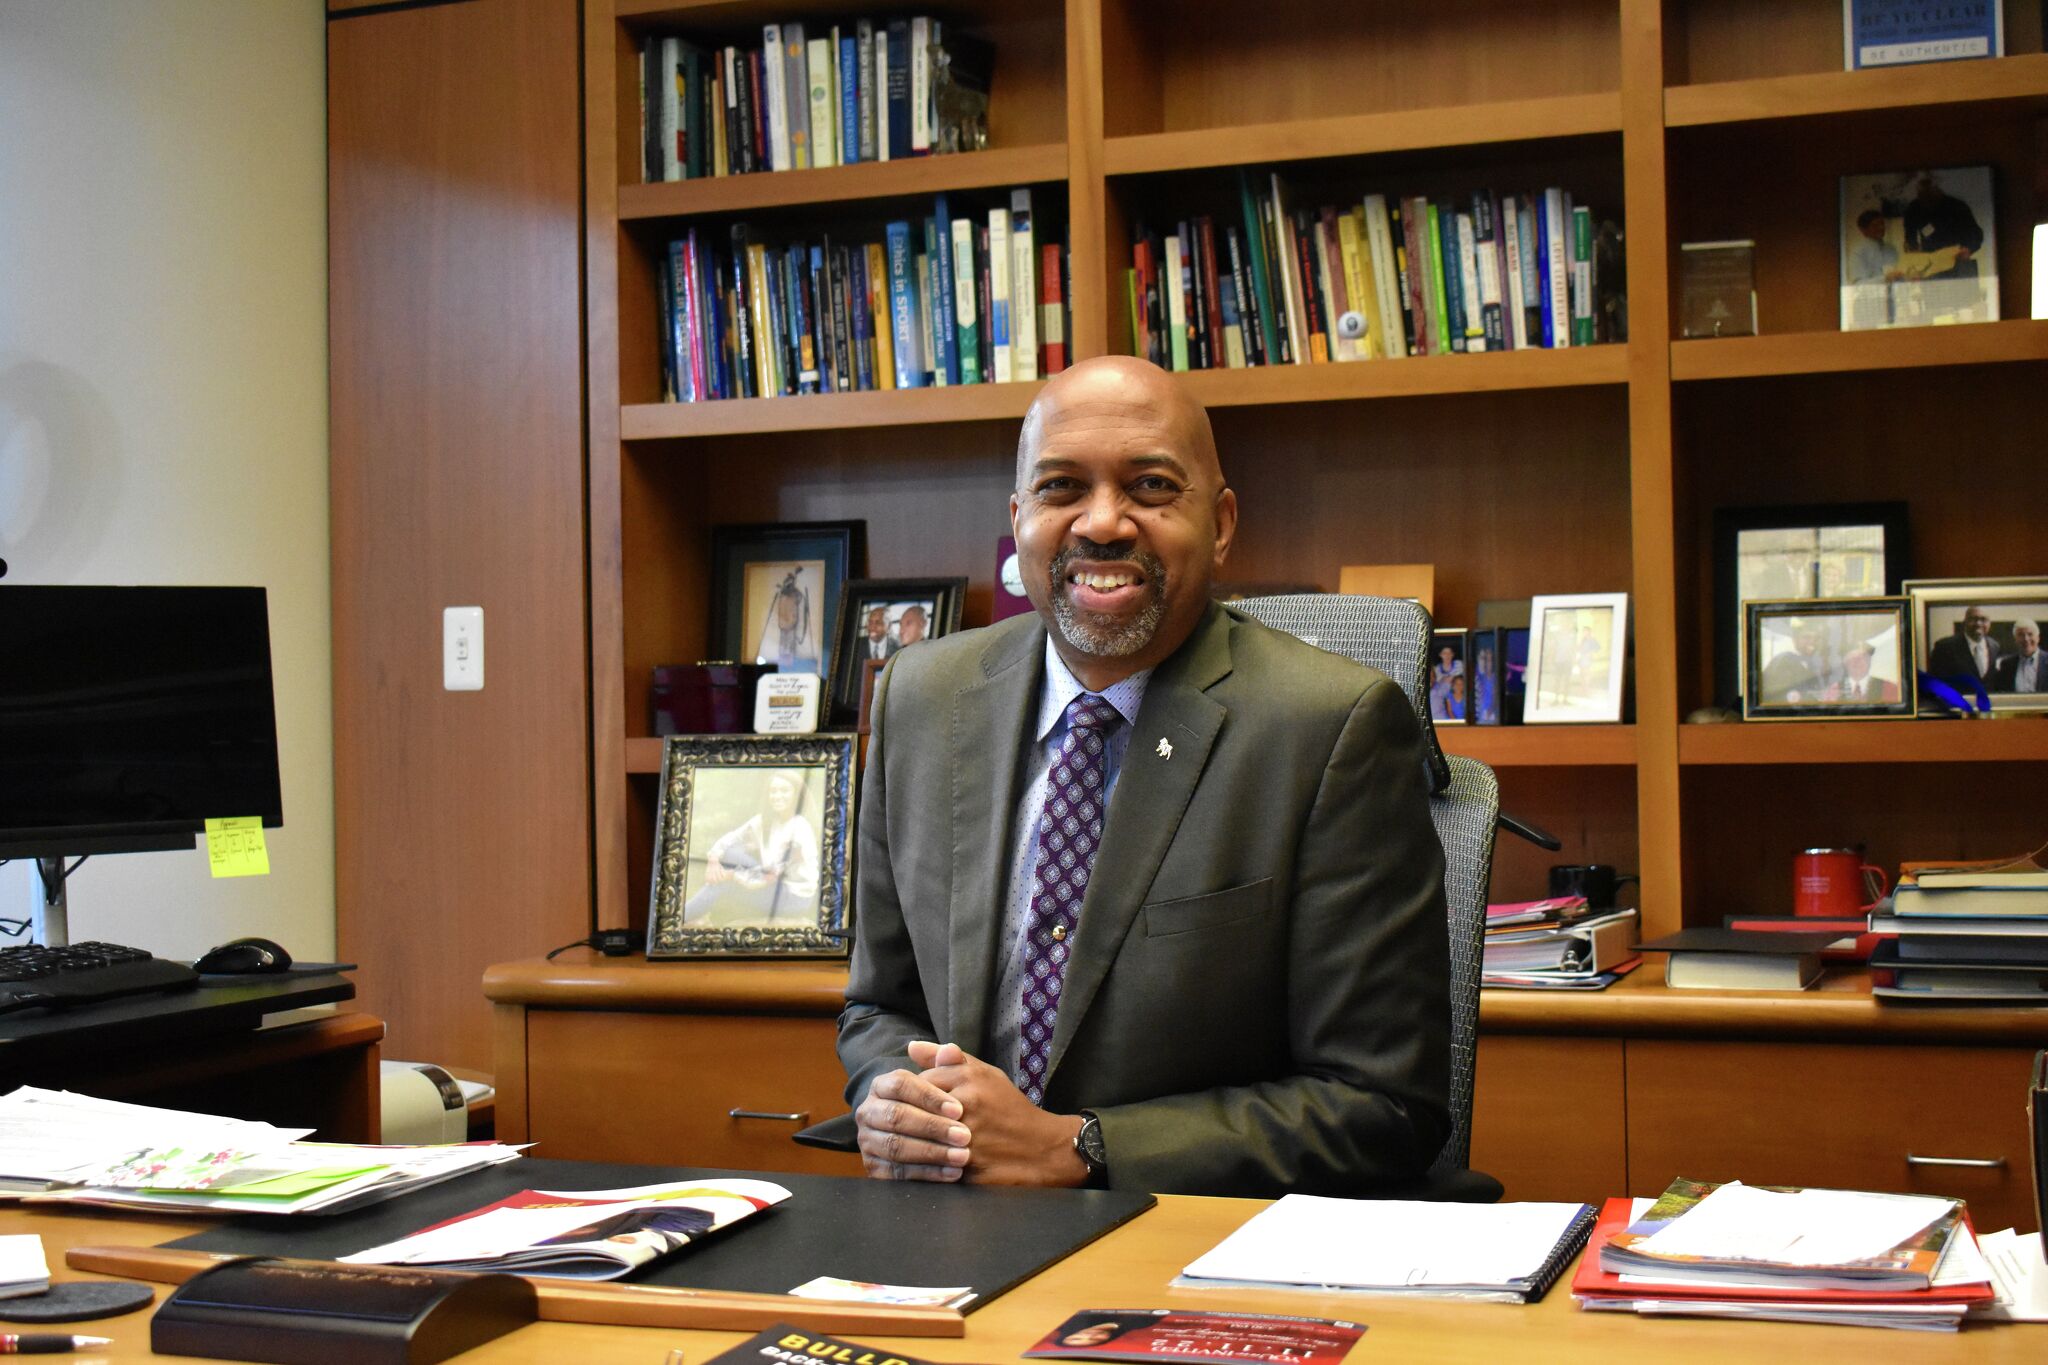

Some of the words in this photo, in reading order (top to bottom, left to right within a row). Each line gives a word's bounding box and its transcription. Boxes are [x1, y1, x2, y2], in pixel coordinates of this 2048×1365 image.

[1870, 49, 1886, 60] BE
[1897, 43, 1980, 57] AUTHENTIC
[843, 54, 854, 92] PRIMAL
[845, 95, 856, 159] LEADERSHIP
[893, 235, 907, 276] Ethics
[939, 232, 948, 265] AMERICAN
[1551, 239, 1563, 264] LOVE
[895, 278, 908, 292] in
[941, 266, 950, 293] COUNCIL
[1553, 269, 1567, 328] LEADERSHIP
[737, 307, 752, 360] speeches
[896, 295, 910, 343] SPORT
[934, 308, 943, 337] EQUITY
[944, 305, 954, 341] EDUCATION
[937, 338, 945, 358] TALK
[1151, 1347, 1234, 1358] INVITED
